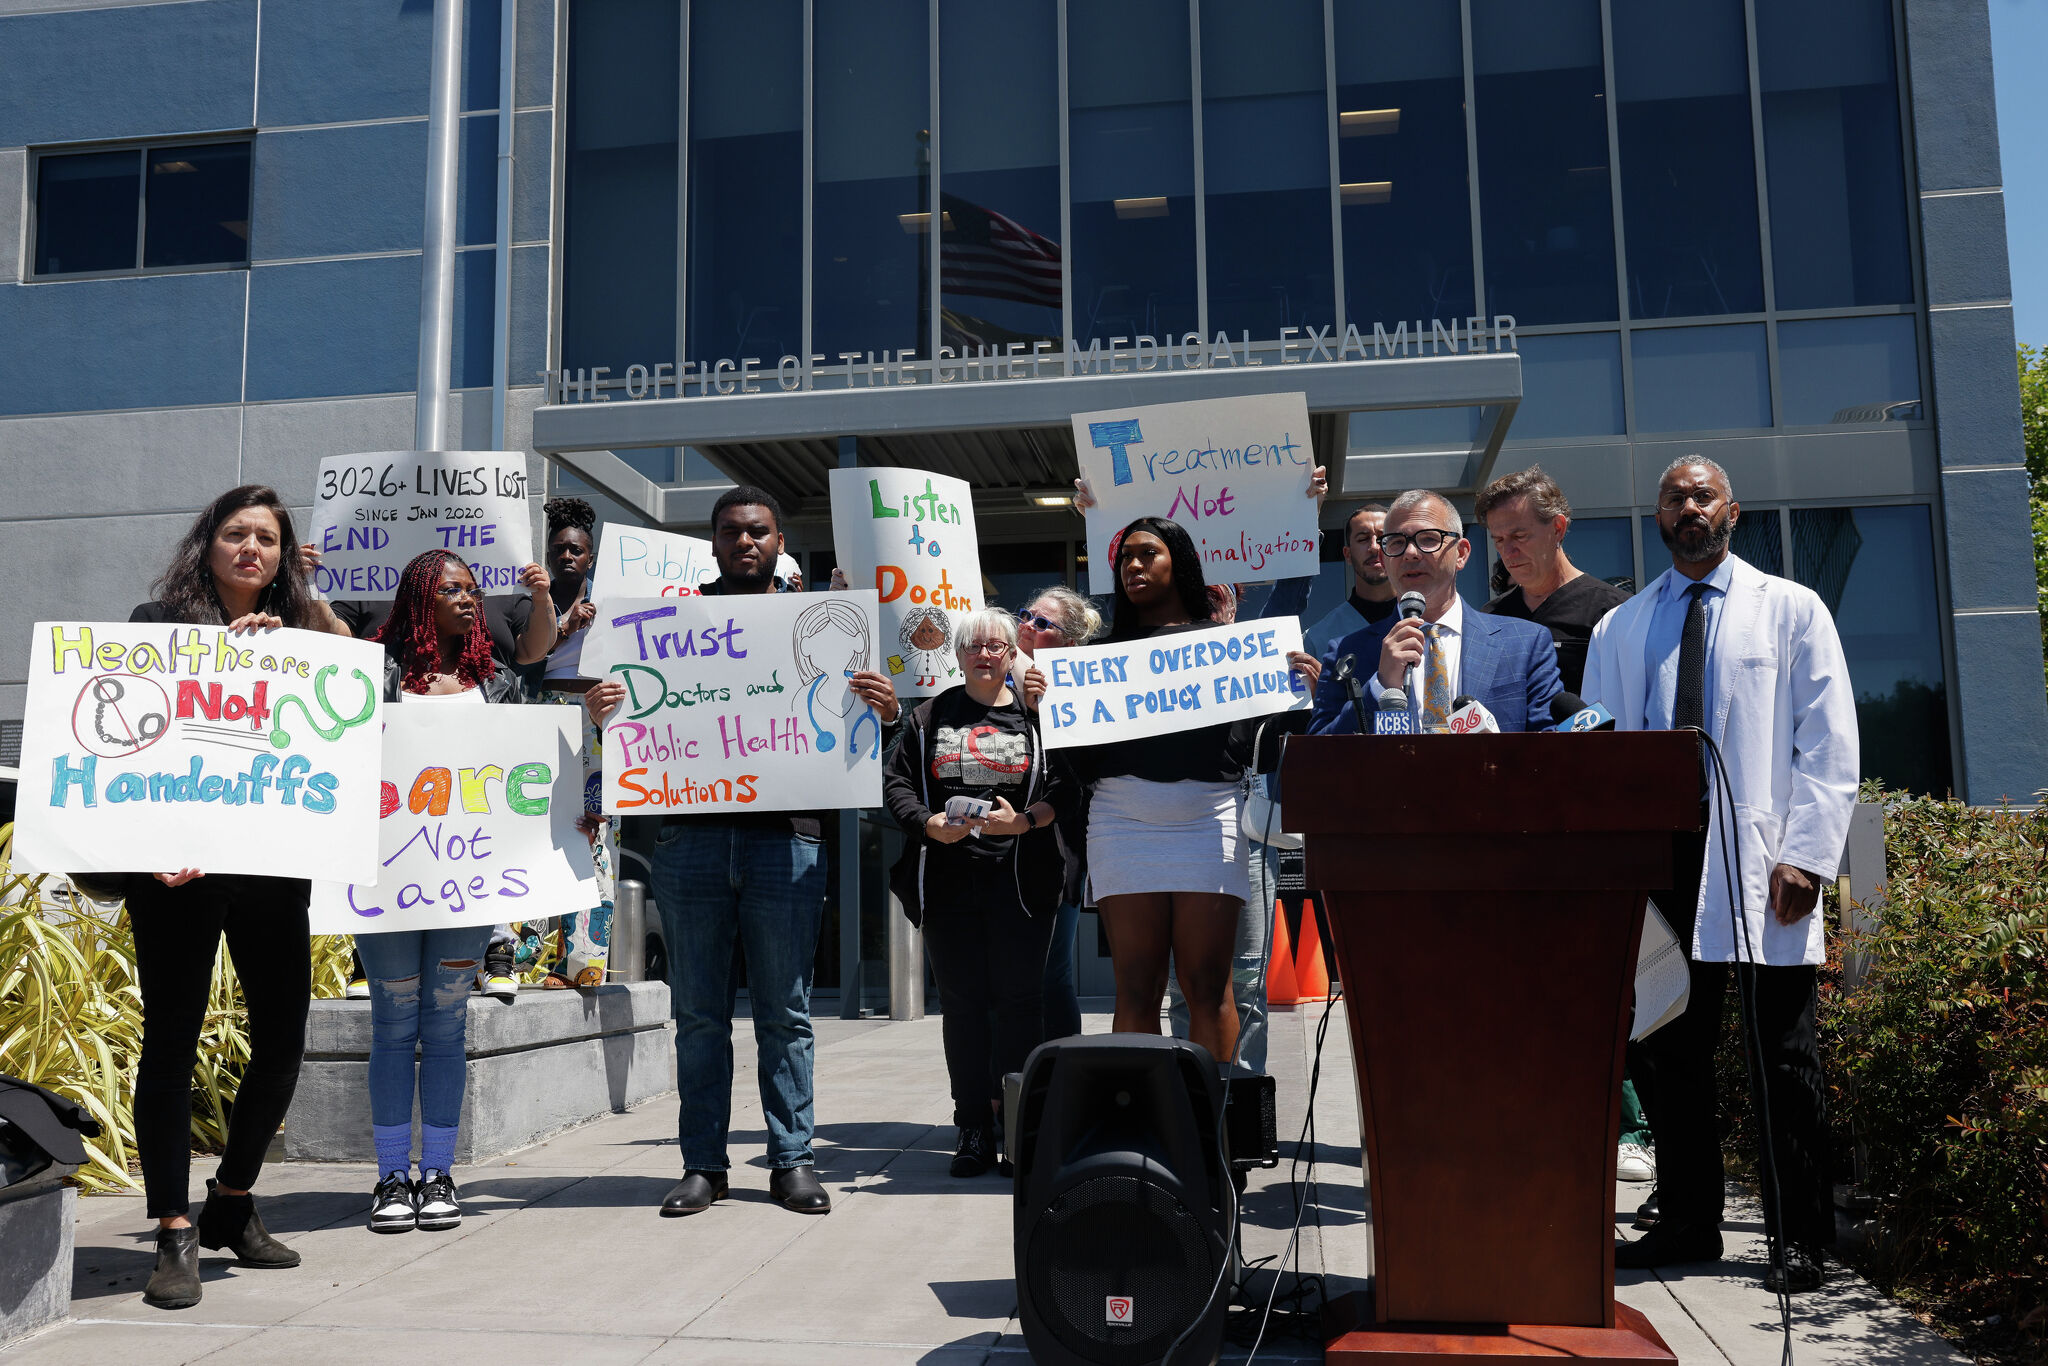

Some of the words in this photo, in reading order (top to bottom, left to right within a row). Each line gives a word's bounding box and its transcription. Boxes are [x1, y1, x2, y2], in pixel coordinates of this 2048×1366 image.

[537, 365, 611, 404] THE
[625, 357, 761, 399] OFFICE
[778, 353, 825, 391] OF
[838, 348, 916, 387] THE
[937, 340, 1051, 383] CHIEF
[1072, 329, 1262, 374] MEDICAL
[1280, 314, 1518, 363] EXAMINER
[1088, 418, 1308, 486] Treatment
[321, 464, 407, 500] 3026+
[416, 465, 488, 496] LIVES
[495, 467, 527, 500] LOST
[869, 478, 961, 525] Listen
[1166, 484, 1235, 520] Not
[355, 508, 398, 521] SINCE
[407, 506, 438, 521] JAN
[445, 507, 484, 519] 2020
[323, 525, 390, 553] END
[436, 524, 497, 548] THE
[619, 535, 711, 584] Public
[908, 524, 941, 557] to
[875, 565, 972, 612] Doctors
[51, 626, 310, 678] Healthcare
[611, 605, 748, 661] Trust
[1051, 655, 1129, 687] EVERY
[1149, 629, 1278, 674] OVERDOSE
[176, 679, 271, 731] Not
[609, 663, 731, 720] Doctors
[746, 669, 785, 697] and
[1051, 701, 1077, 728] IS
[1092, 699, 1115, 723] A
[1125, 682, 1202, 719] POLICY
[1213, 669, 1306, 704] FAILURE
[607, 722, 700, 768] Public
[717, 714, 808, 760] Health
[1376, 716, 1410, 732] KCBS
[1450, 707, 1482, 734] 26
[50, 753, 339, 814] Handcuffs
[934, 754, 959, 768] HEALTH
[616, 768, 760, 808] Solutions
[382, 822, 492, 866] Not
